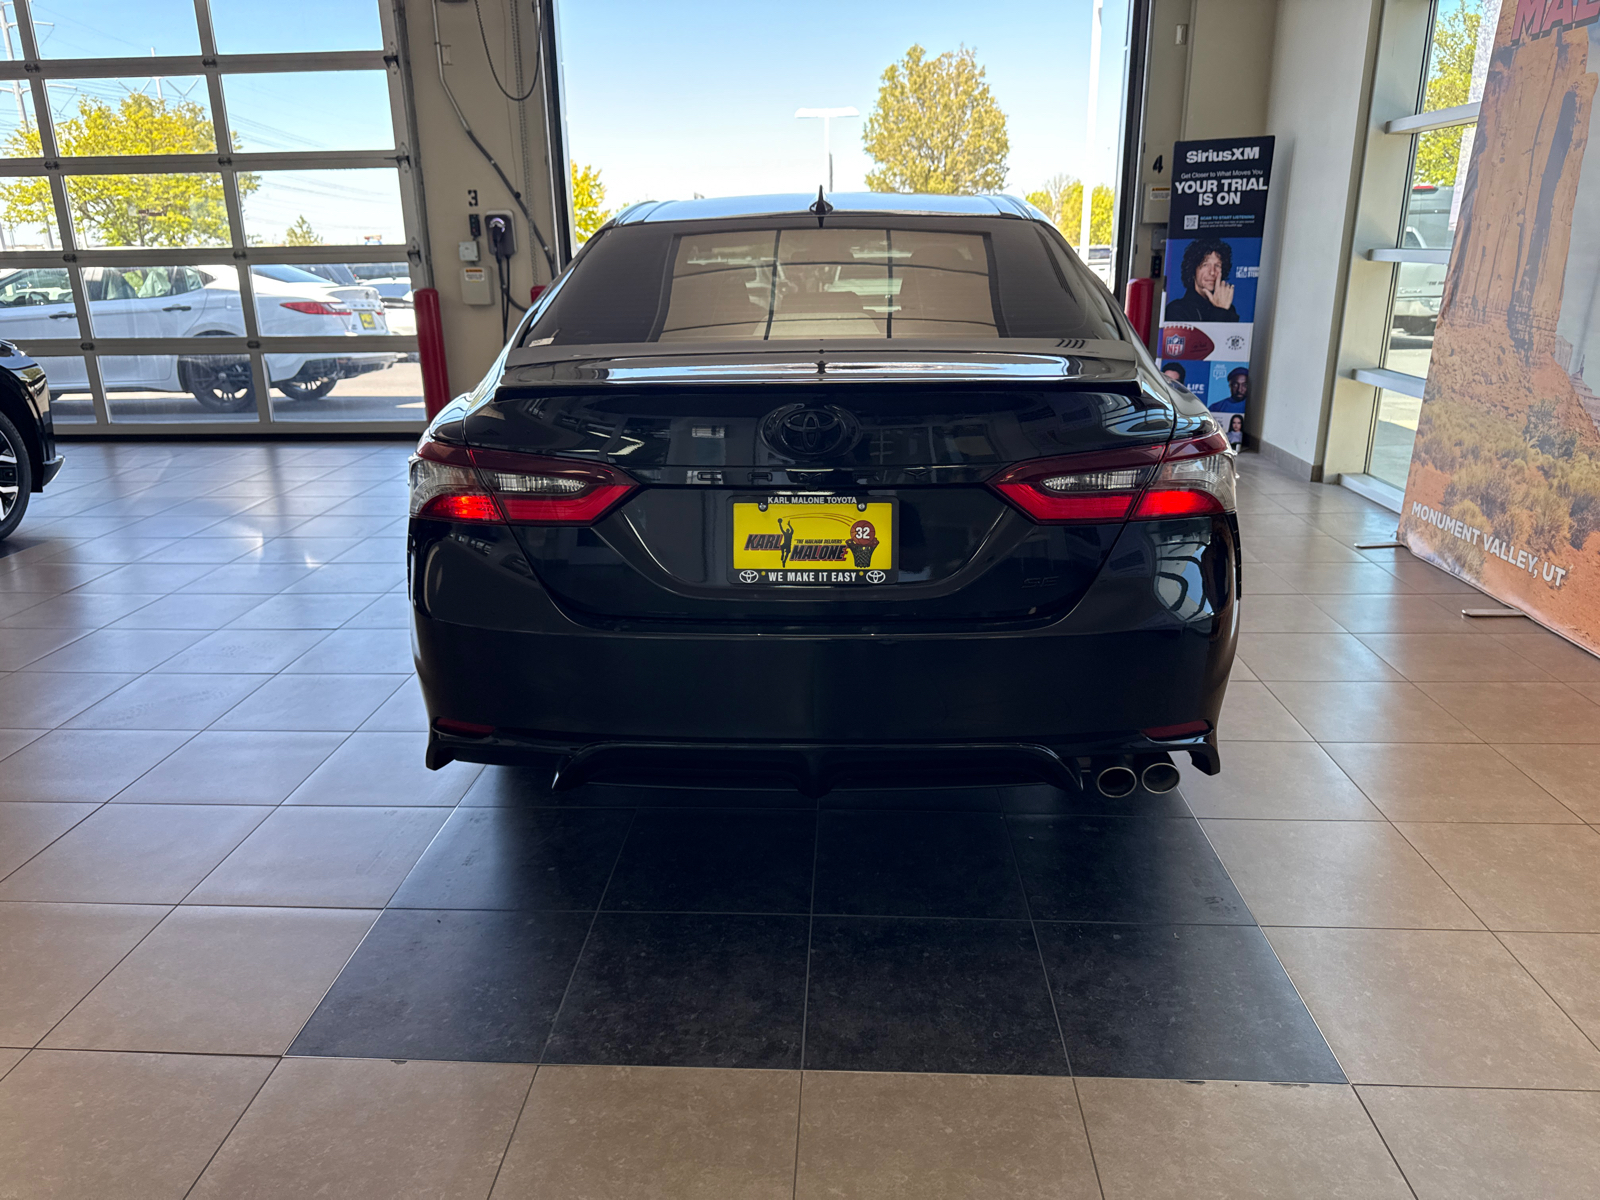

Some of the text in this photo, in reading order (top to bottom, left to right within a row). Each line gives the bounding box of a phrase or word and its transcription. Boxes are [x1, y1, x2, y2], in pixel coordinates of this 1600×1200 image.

[1186, 146, 1260, 163] SiriusXM
[1152, 155, 1164, 174] 4
[1175, 179, 1218, 194] YOUR
[1221, 177, 1268, 191] TRIAL
[467, 189, 479, 207] 3
[1198, 191, 1241, 206] IS ON
[1167, 344, 1183, 356] NFL
[1186, 383, 1205, 391] LIFE
[826, 496, 857, 504] TOYOTA
[855, 526, 871, 539] 32
[744, 534, 783, 551] KARL
[1411, 501, 1566, 587] MONUMENT VALLEY, UT
[789, 545, 848, 561] MALONE
[768, 572, 857, 582] WE MAKE IT EASY
